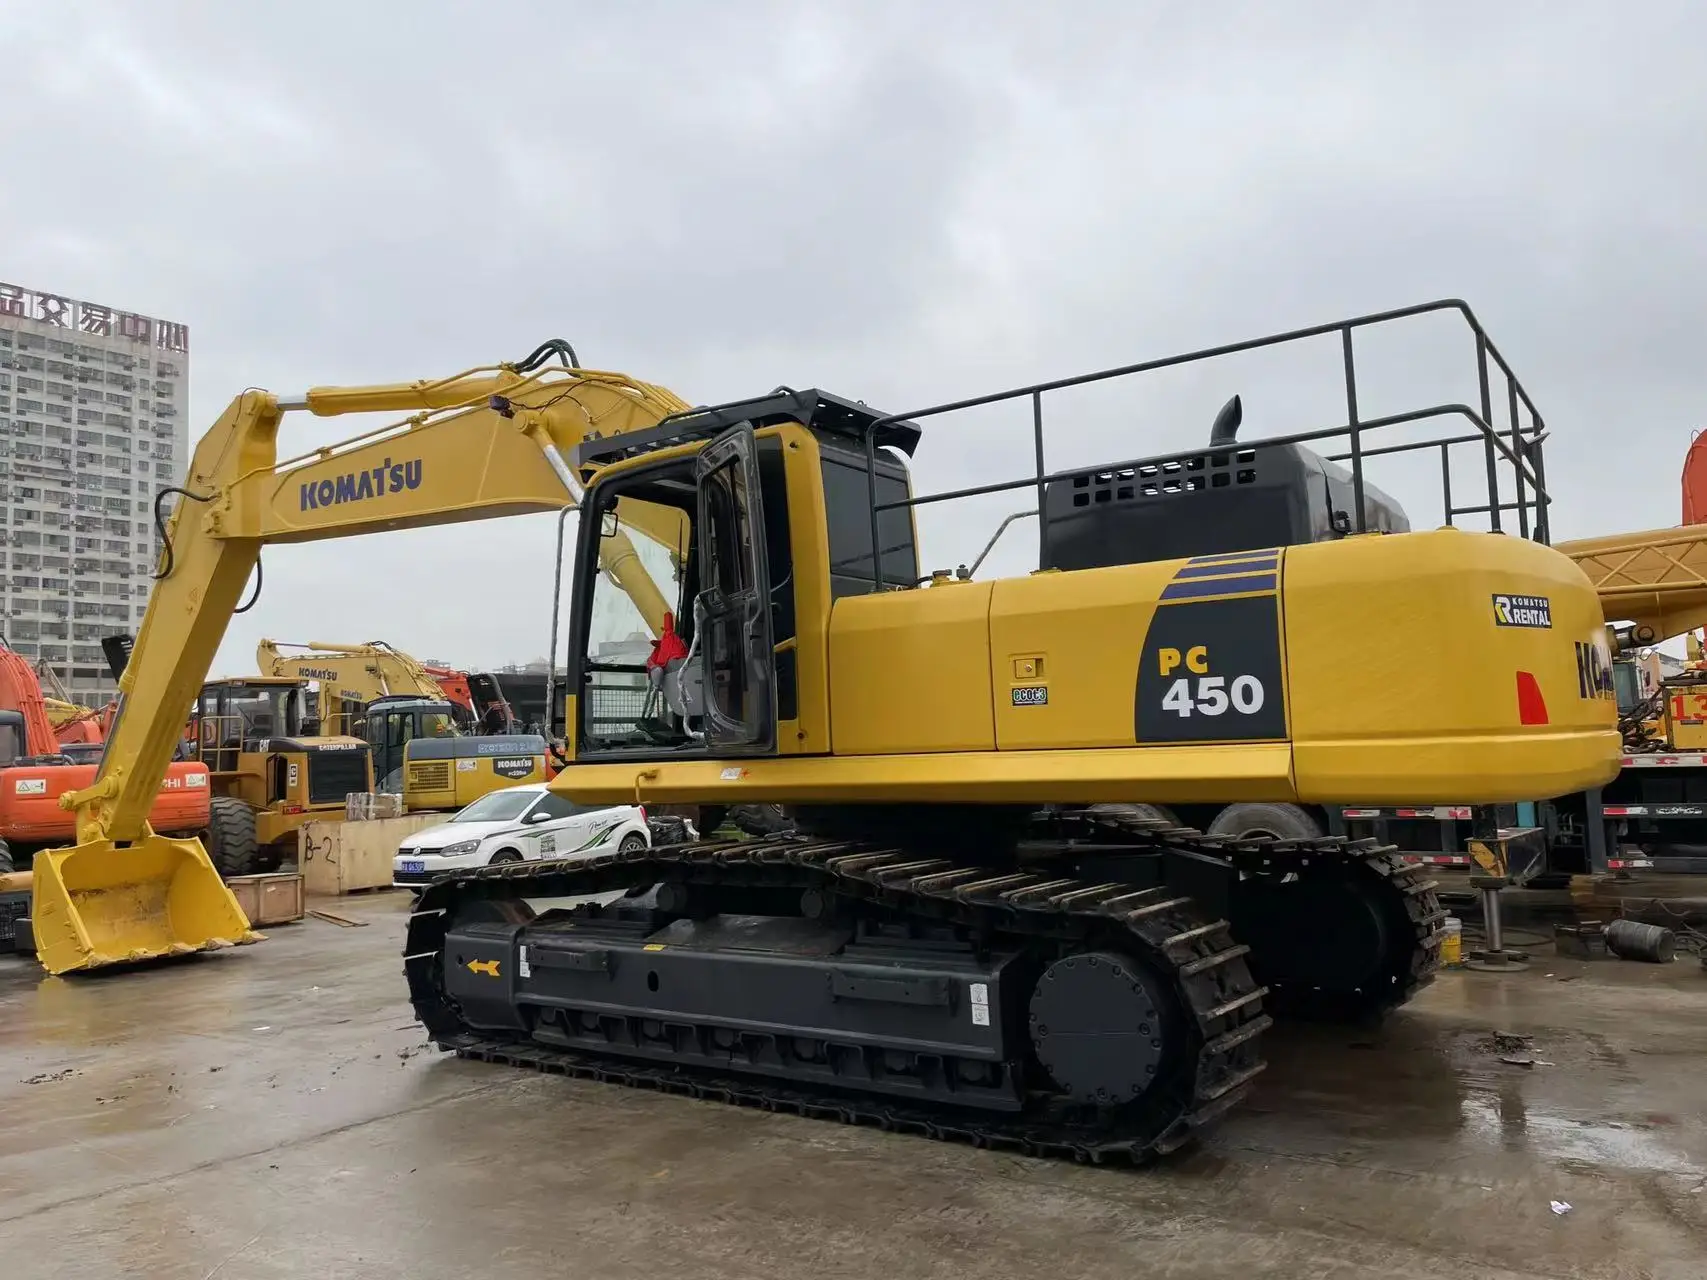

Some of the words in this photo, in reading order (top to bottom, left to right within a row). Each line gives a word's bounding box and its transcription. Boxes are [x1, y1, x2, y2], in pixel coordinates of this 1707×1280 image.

[300, 457, 422, 511] KOMATSU
[1512, 597, 1548, 607] KOMATSU
[1513, 608, 1551, 626] RENTAL
[1158, 645, 1209, 676] PC
[298, 667, 338, 681] KOMATSU
[1161, 675, 1265, 718] 450
[497, 759, 532, 769] KOMATSU
[304, 833, 336, 864] B-2
